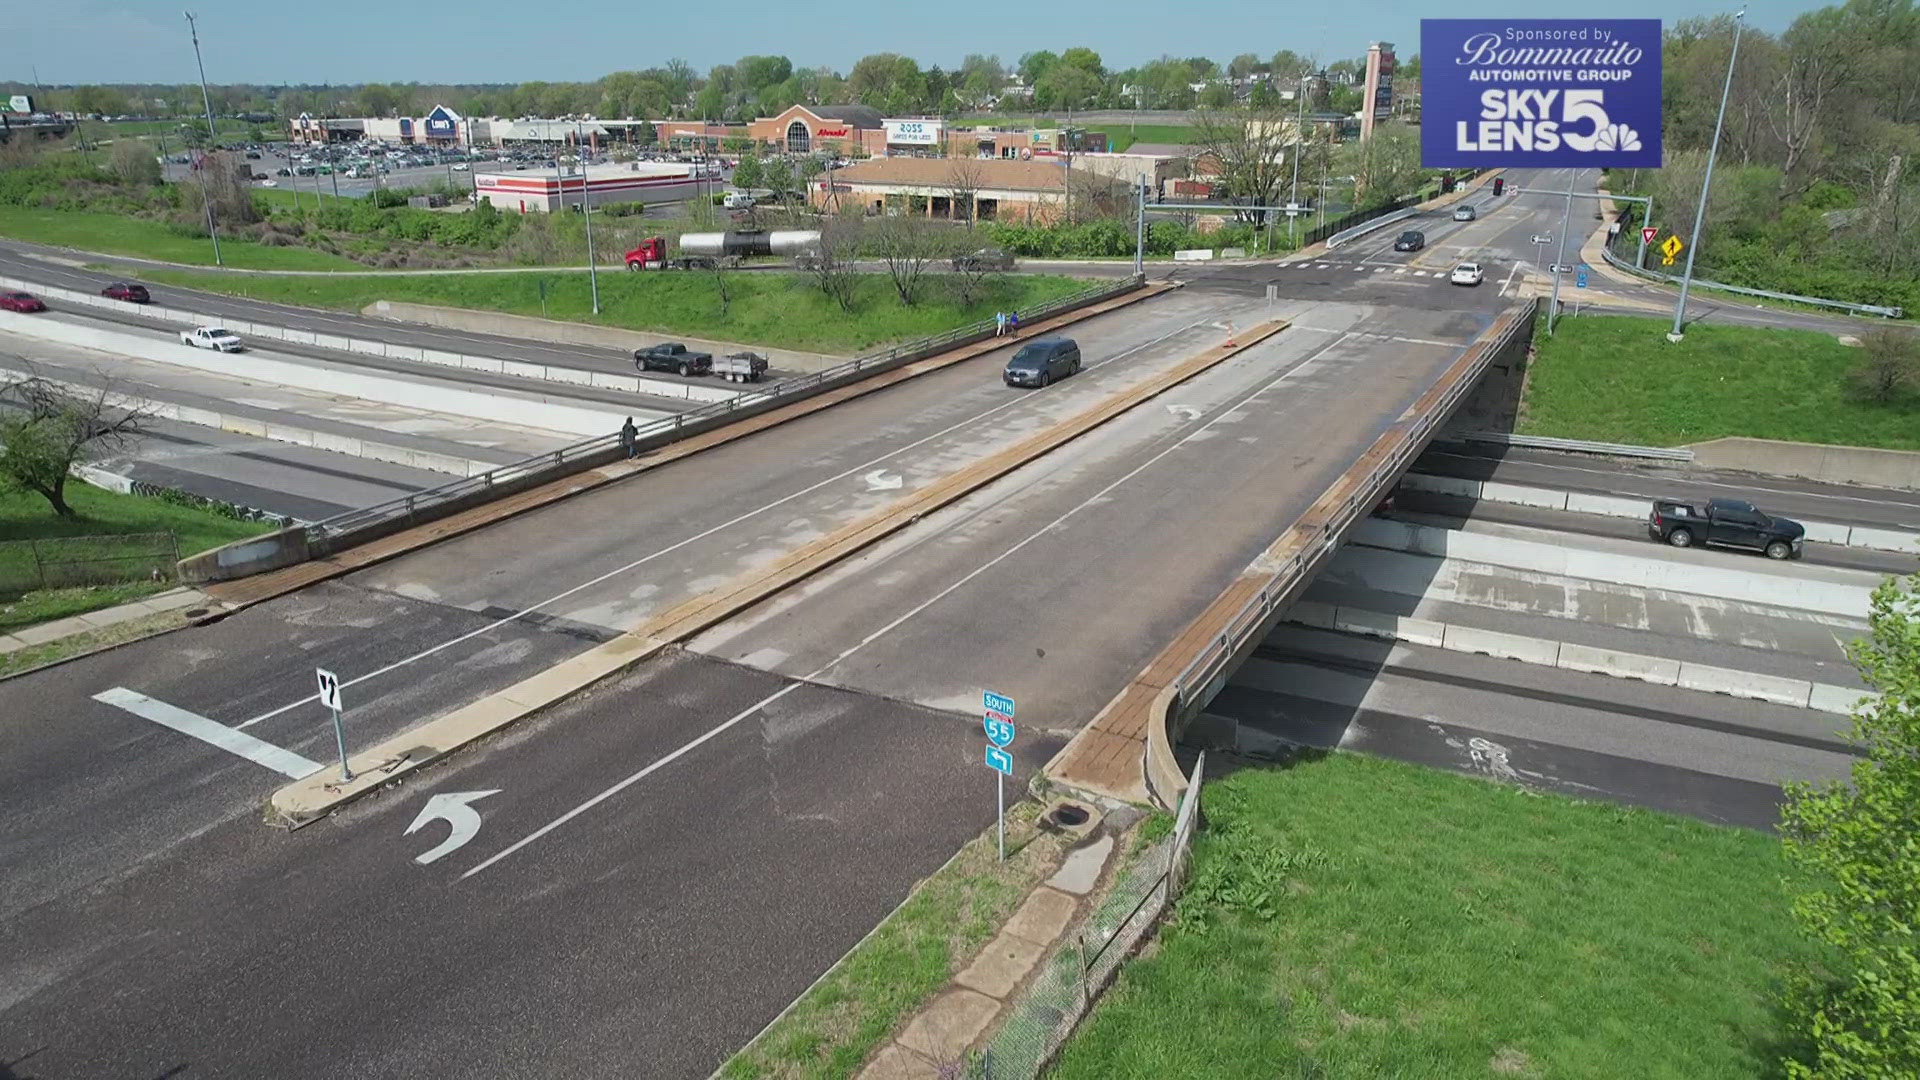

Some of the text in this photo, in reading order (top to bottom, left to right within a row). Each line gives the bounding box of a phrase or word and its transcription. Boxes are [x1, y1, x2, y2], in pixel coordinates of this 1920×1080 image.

[900, 123, 923, 133] ROSS
[985, 695, 1012, 714] SOUTH
[989, 722, 1010, 740] 55
